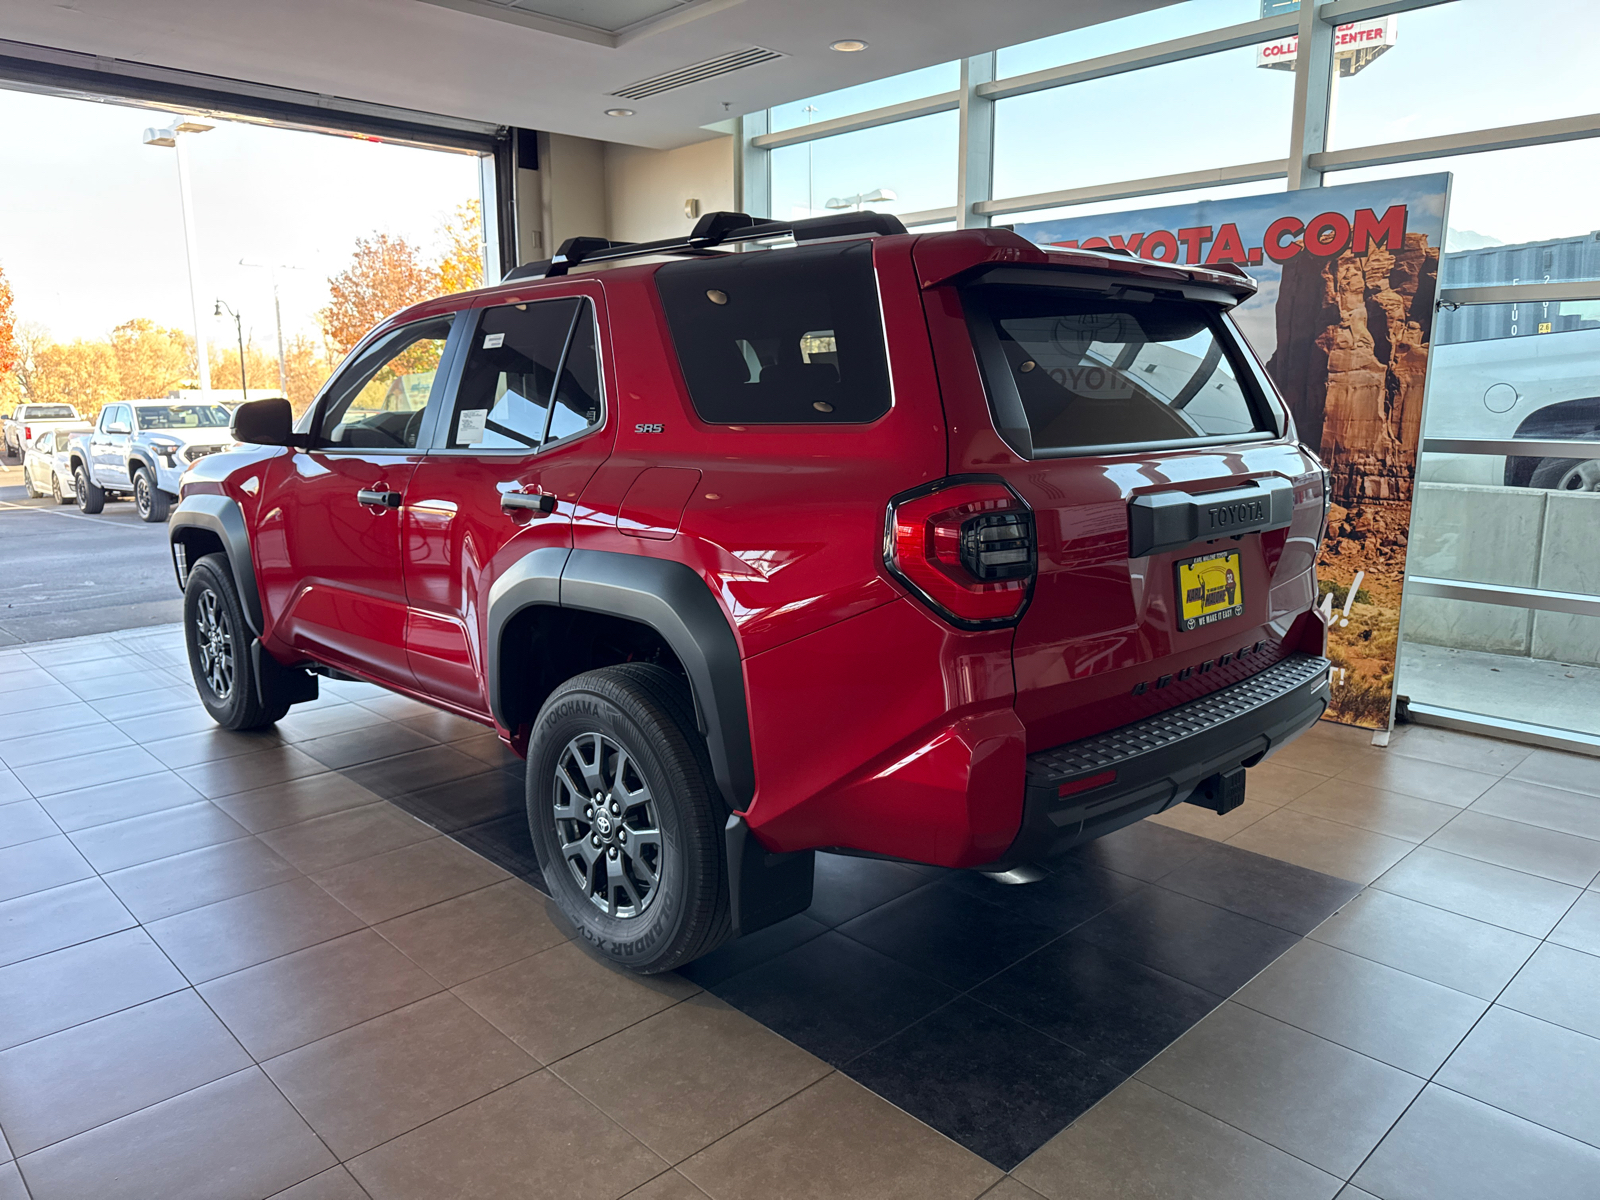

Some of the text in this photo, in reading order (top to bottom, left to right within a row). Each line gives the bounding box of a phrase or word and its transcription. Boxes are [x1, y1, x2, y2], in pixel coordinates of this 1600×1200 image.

[1335, 27, 1383, 46] CENTER
[1050, 204, 1408, 266] YOTA.COM
[634, 423, 665, 434] SR5
[1208, 500, 1265, 529] TOYOTA
[1199, 617, 1206, 626] WE
[1206, 614, 1217, 624] MAKE
[1223, 610, 1232, 618] EASY
[545, 700, 601, 729] YOKOHAMA
